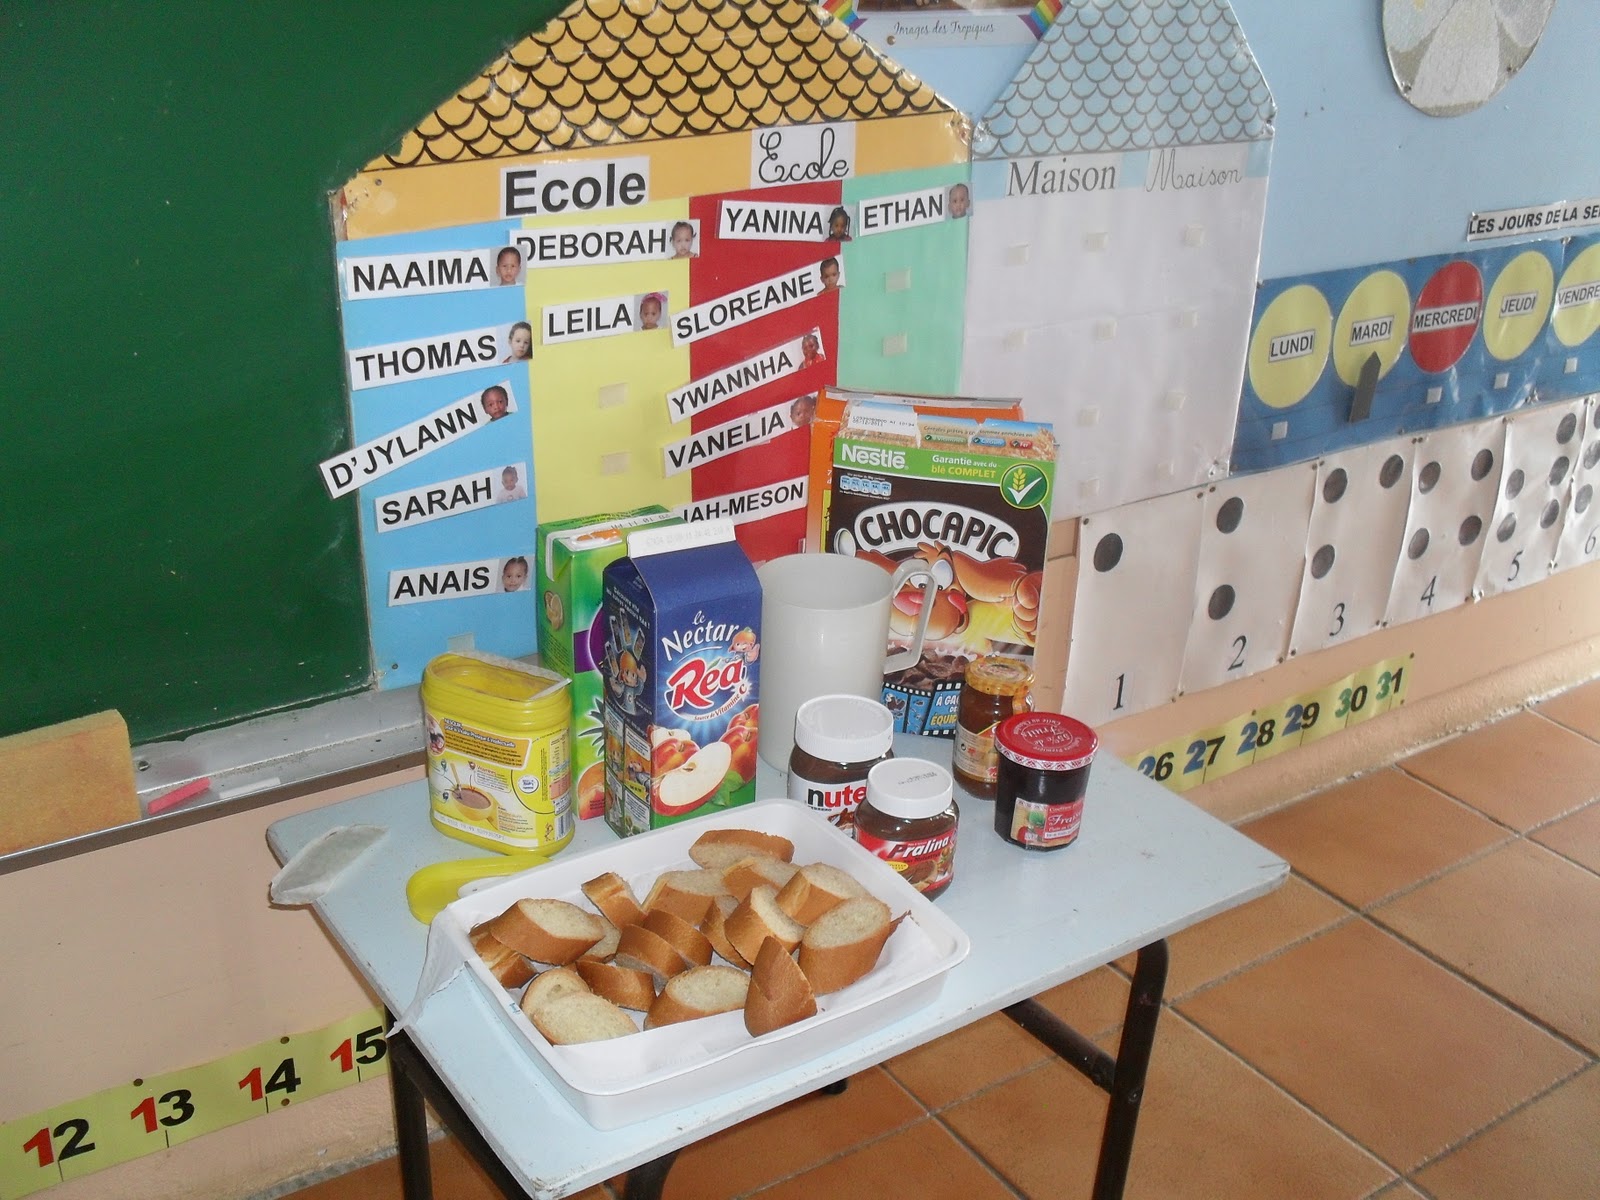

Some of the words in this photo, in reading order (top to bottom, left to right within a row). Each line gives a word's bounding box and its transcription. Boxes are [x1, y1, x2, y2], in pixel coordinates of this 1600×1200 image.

[894, 21, 928, 39] Images
[932, 20, 948, 34] des
[950, 20, 994, 40] Tropiques
[758, 127, 850, 184] Ecole
[1145, 148, 1244, 193] Maison
[504, 163, 647, 215] Ecole
[1007, 161, 1117, 197] Maison
[725, 208, 824, 236] YANINA
[863, 195, 945, 230] ETHAN
[1467, 215, 1495, 235] LES
[1498, 211, 1543, 231] JOURS
[1545, 209, 1561, 225] DE
[1562, 207, 1578, 222] LA
[1583, 204, 1600, 220] SE
[516, 228, 667, 262] DEBORAH
[352, 257, 490, 293] NAAIMA
[547, 304, 632, 337] LEILA
[676, 272, 815, 341] SLOREANE
[1414, 307, 1477, 329] MERCREDI
[1501, 296, 1537, 314] JEUDI
[1270, 336, 1315, 357] LUNDI
[1351, 320, 1393, 340] MARDI
[356, 334, 497, 382] THOMAS
[672, 350, 794, 416] YWANNHA
[668, 409, 786, 468] VANELIA
[1019, 440, 1030, 448] Fer
[841, 443, 906, 471] Nestlé
[931, 464, 946, 474] blé
[948, 465, 997, 480] COMPLET
[932, 454, 973, 467] Garantie
[973, 459, 989, 468] avec
[989, 459, 998, 468] du
[381, 476, 493, 526] SARAH
[859, 508, 1014, 563] CHOCAPIC
[1584, 525, 1600, 555] 6
[394, 565, 491, 600] ANAIS
[1507, 550, 1524, 582] 5
[1421, 576, 1438, 607] 4
[692, 611, 706, 625] le
[1329, 602, 1346, 637] 3
[662, 624, 739, 661] Nectar
[1227, 635, 1248, 671] 2
[714, 693, 740, 717] Vitamine
[738, 683, 747, 695] C
[1113, 673, 1125, 711] 1
[1021, 725, 1055, 738] Fruits
[1183, 735, 1226, 775] 27
[1236, 719, 1276, 756] 28
[1282, 702, 1320, 737] 29
[1335, 685, 1368, 718] 30
[1375, 667, 1404, 701] 31
[808, 785, 867, 808] nute
[23, 1118, 96, 1168] 12
[130, 1088, 196, 1134] 13
[238, 1057, 302, 1102] 14
[330, 1025, 389, 1074] 15
